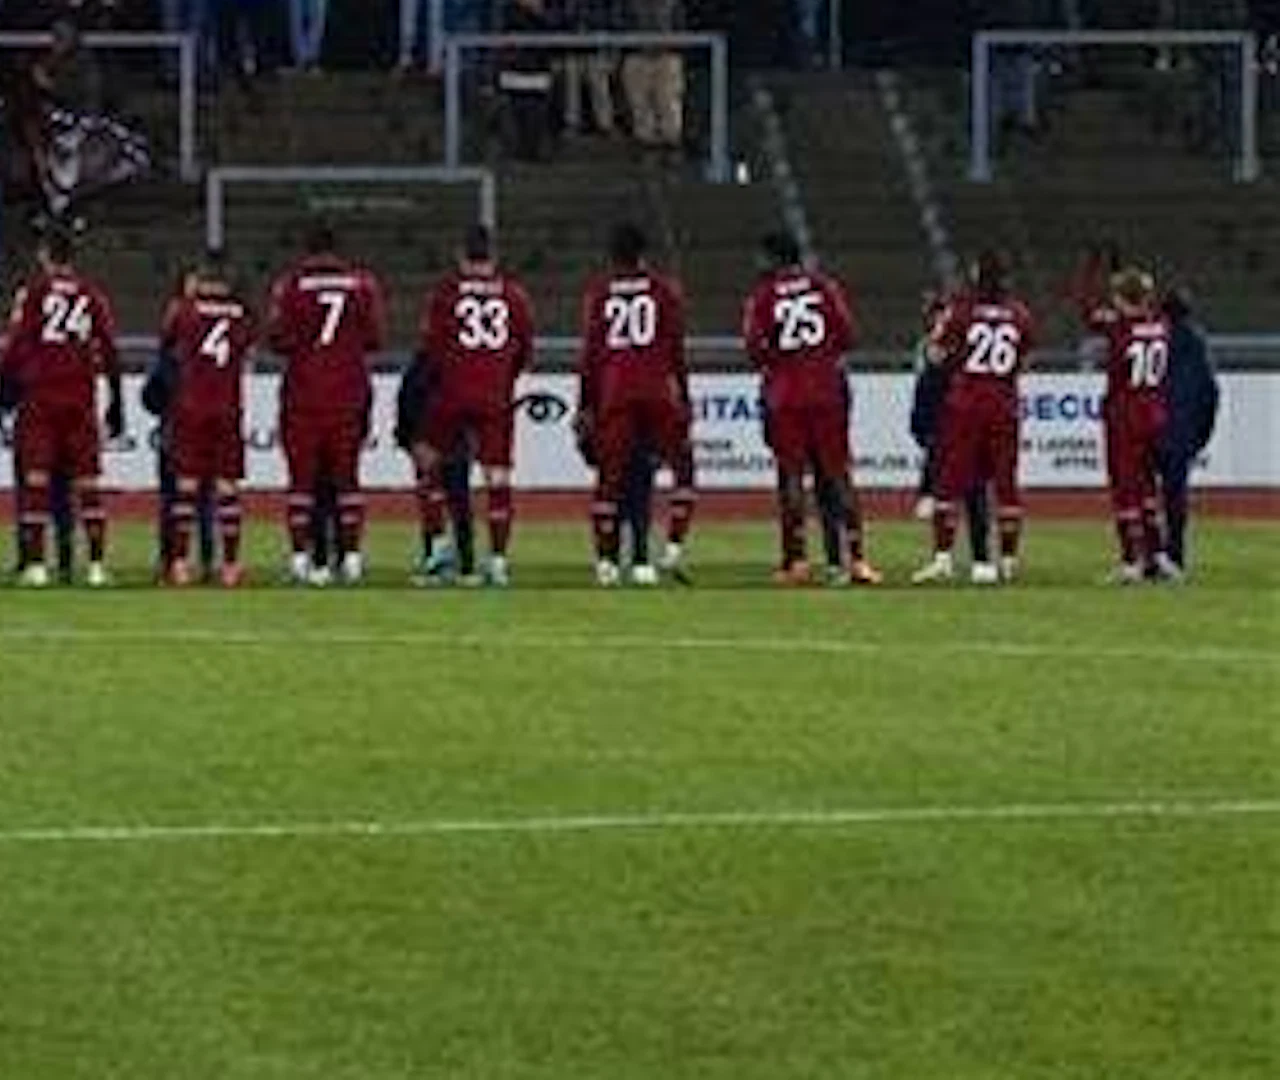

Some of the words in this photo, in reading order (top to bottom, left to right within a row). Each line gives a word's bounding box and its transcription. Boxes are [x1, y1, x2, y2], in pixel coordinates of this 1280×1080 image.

[42, 294, 93, 343] 24
[200, 319, 231, 368] 4
[317, 290, 347, 346] 7
[453, 296, 510, 351] 33
[604, 294, 656, 350] 20
[774, 291, 826, 351] 25
[965, 323, 1022, 375] 26
[1127, 340, 1168, 388] 10
